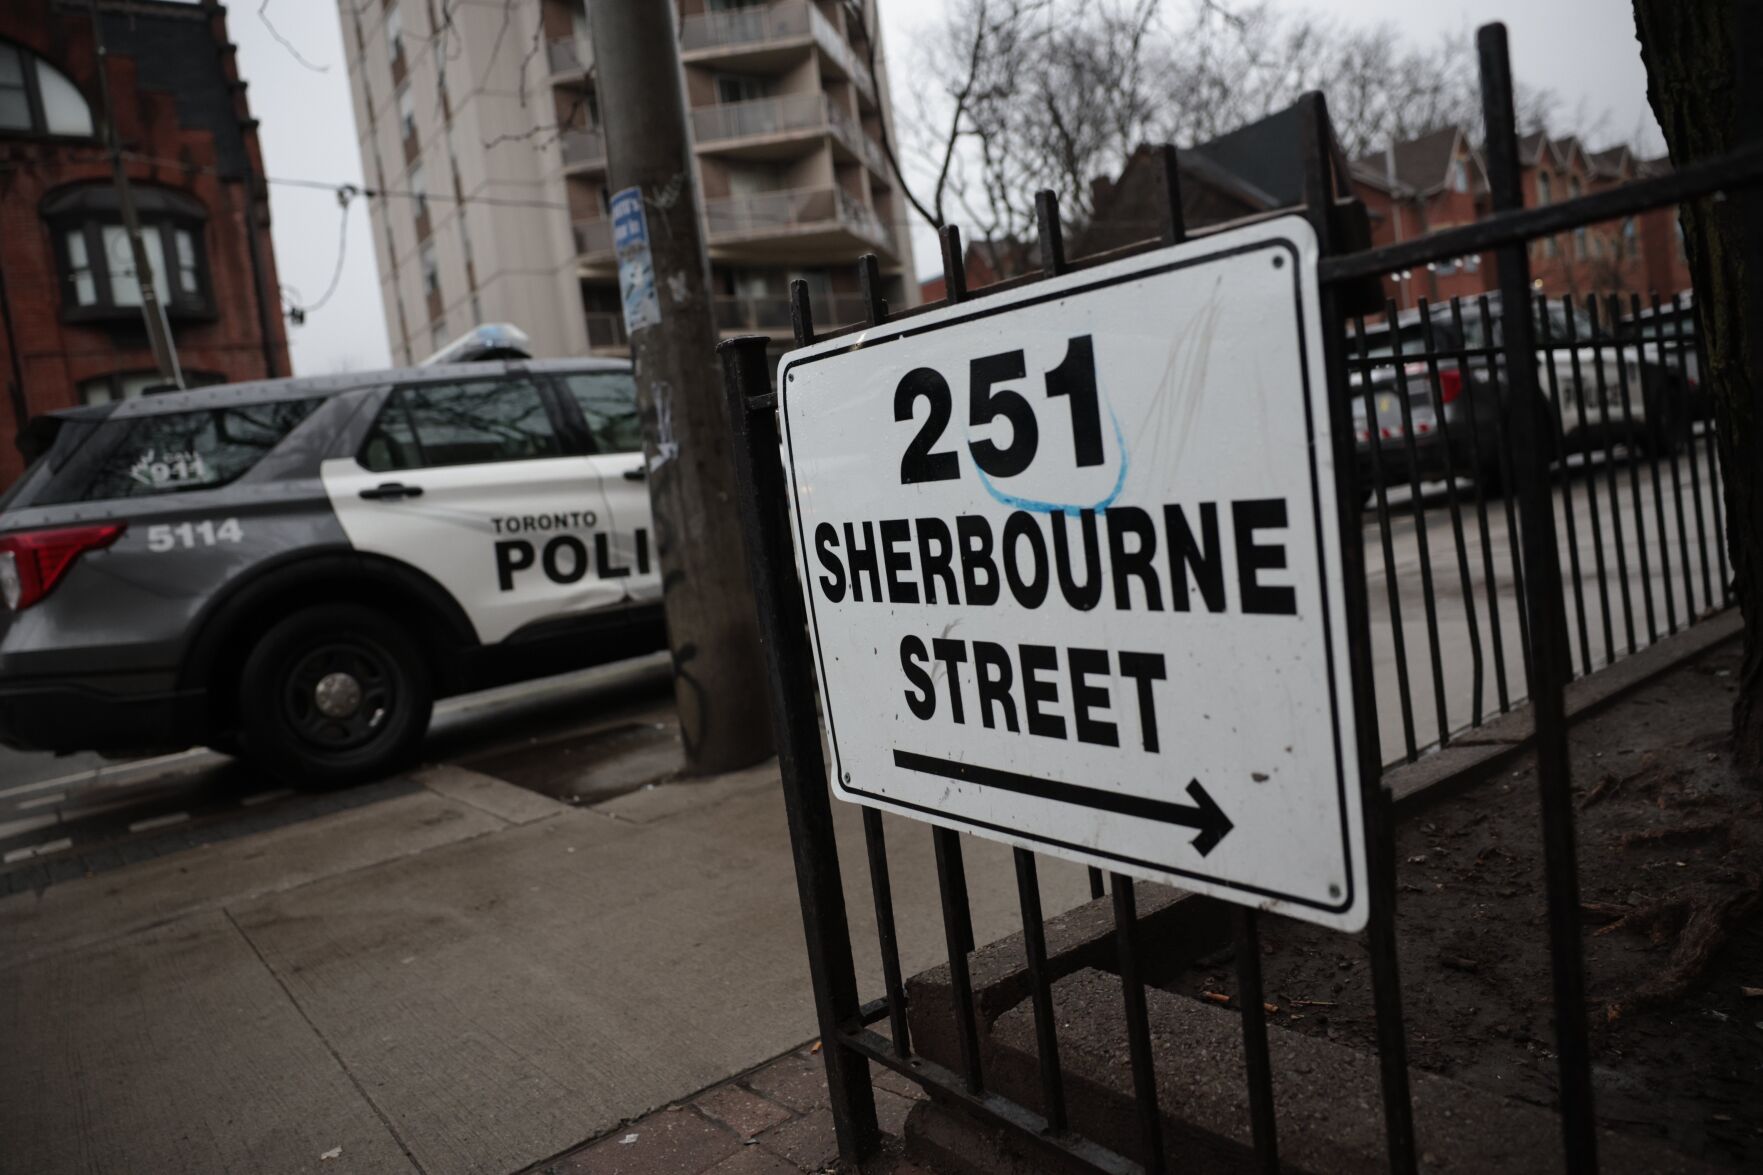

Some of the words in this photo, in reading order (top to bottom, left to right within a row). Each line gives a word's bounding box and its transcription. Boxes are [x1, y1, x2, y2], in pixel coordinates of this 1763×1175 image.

[893, 334, 1105, 485] 251
[147, 517, 244, 553] 5114
[492, 510, 598, 534] TORONTO
[494, 528, 651, 592] POLI
[814, 497, 1298, 616] SHERBOURNE
[899, 634, 1167, 754] STREET
